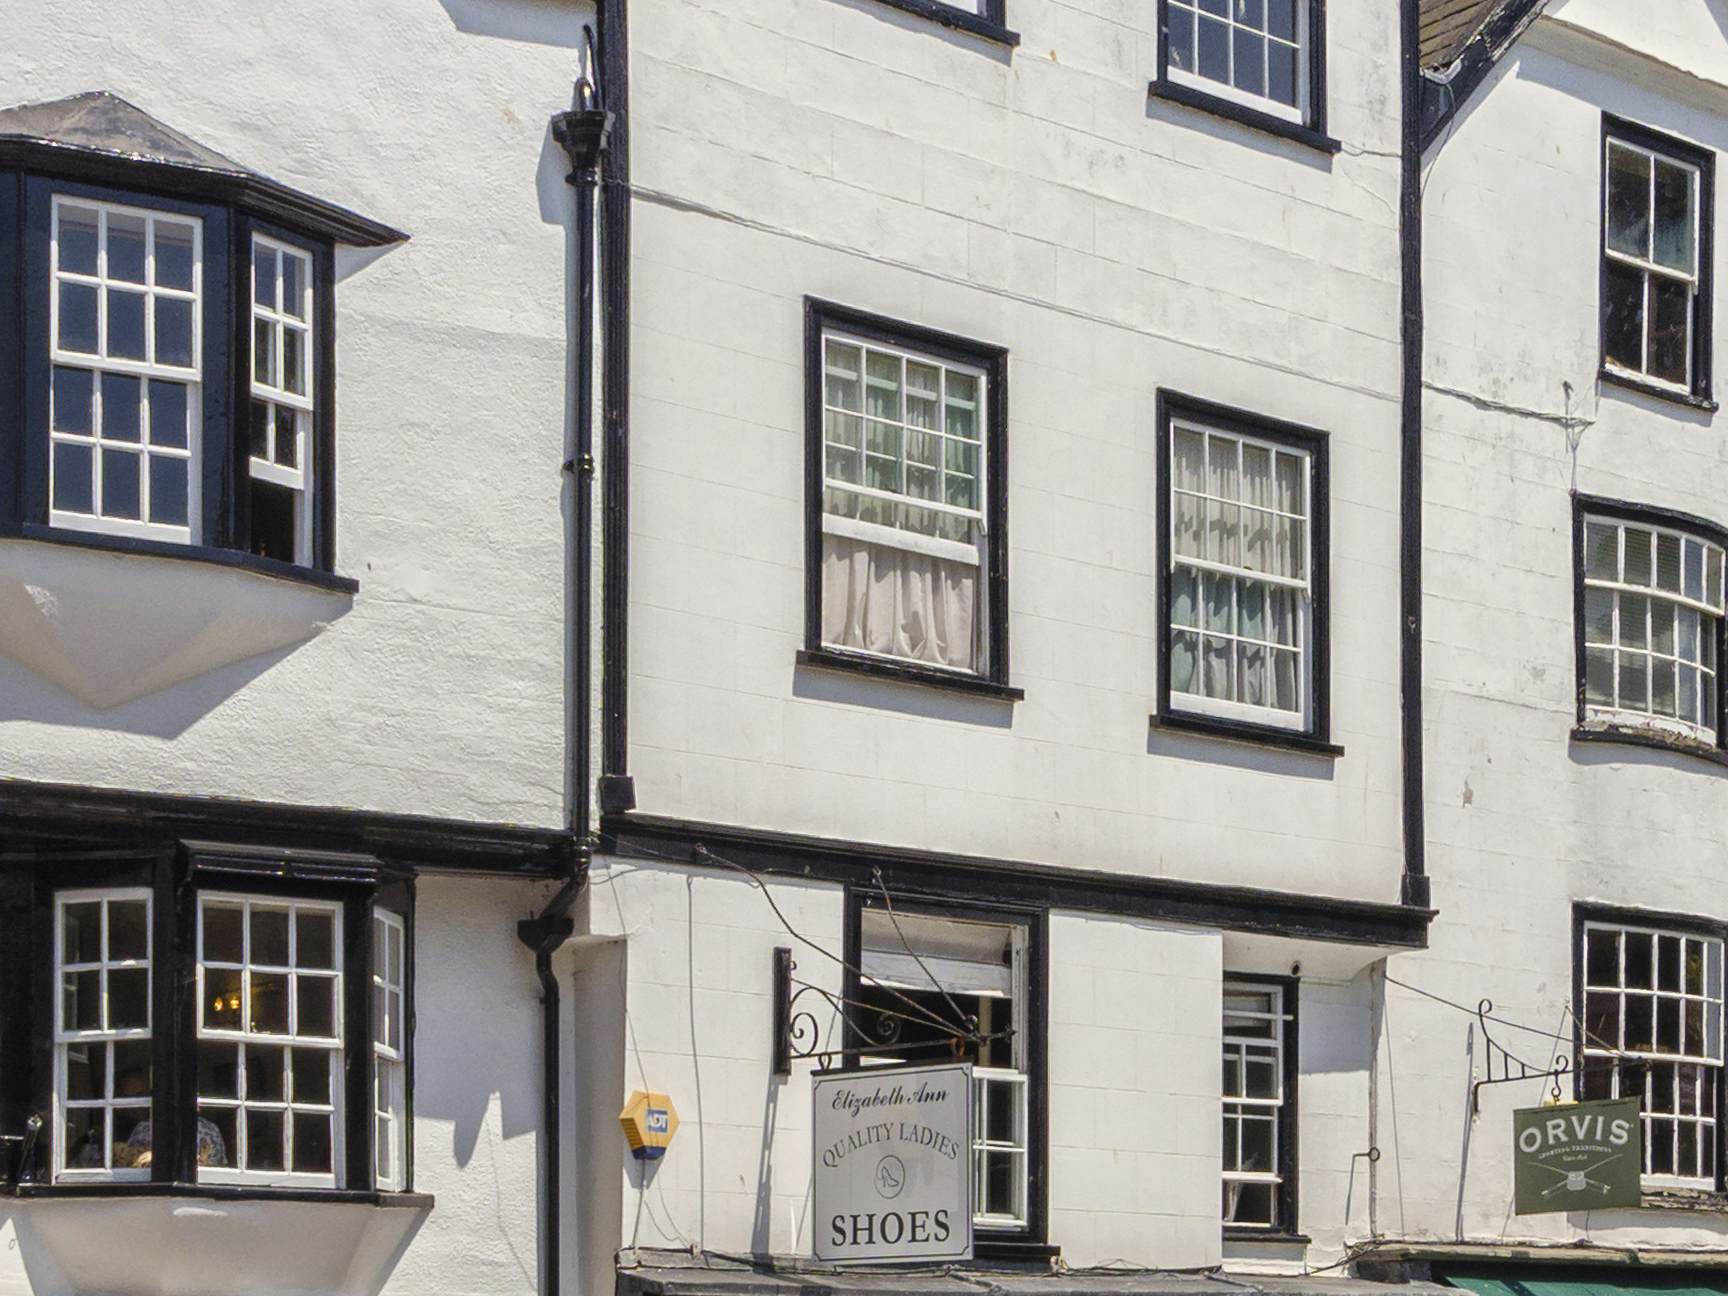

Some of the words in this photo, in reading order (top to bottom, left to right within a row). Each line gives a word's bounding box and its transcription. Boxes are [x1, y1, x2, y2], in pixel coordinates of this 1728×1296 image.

[832, 1087, 904, 1117] Elizabeth
[906, 1081, 948, 1104] Ann
[822, 1122, 894, 1168] QUALITY
[899, 1121, 960, 1161] LADIES
[1518, 1114, 1629, 1153] ORVIS
[831, 1209, 950, 1247] SHOES
